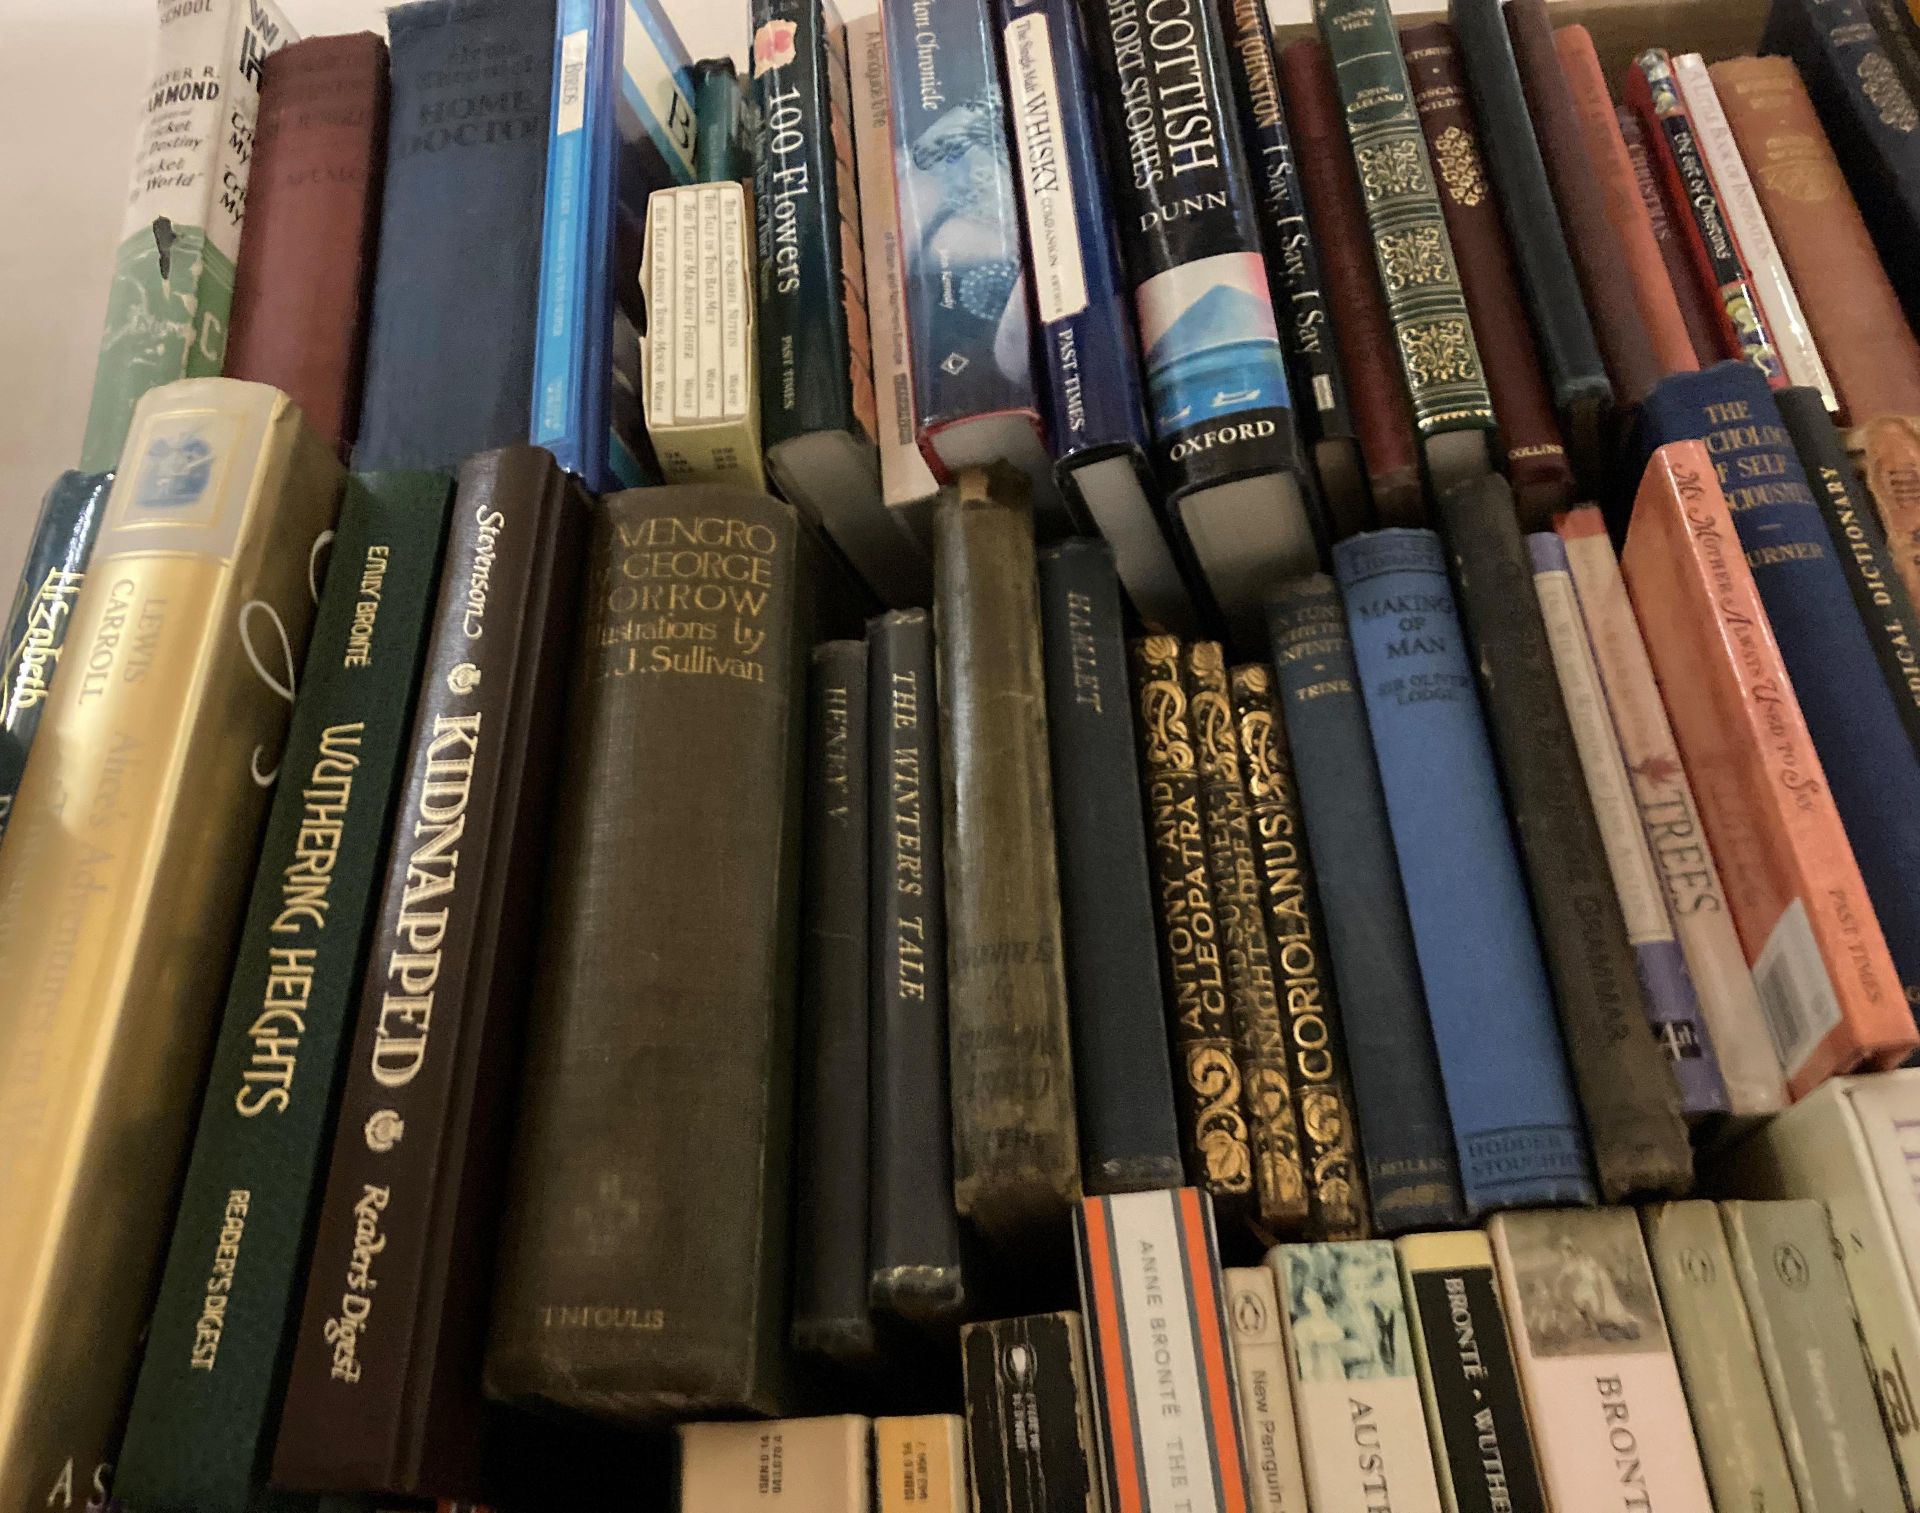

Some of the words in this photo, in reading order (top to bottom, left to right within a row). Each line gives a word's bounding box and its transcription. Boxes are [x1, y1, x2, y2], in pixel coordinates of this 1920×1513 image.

[912, 0, 931, 29] ton
[1015, 20, 1031, 39] The
[1019, 38, 1035, 66] Single
[917, 30, 946, 111] Chronicle
[1147, 0, 1219, 177] COTTISH
[1233, 35, 1281, 129] JOHNSTON
[767, 86, 801, 155] 100
[1024, 90, 1059, 196] WHISKY
[1121, 77, 1163, 189] STORIES
[773, 166, 809, 293] Flowers
[1140, 190, 1227, 233] DUNN
[1058, 328, 1078, 371] PAST
[1064, 373, 1086, 432] TIMES
[1169, 419, 1276, 462] OXFORD
[1704, 401, 1749, 426] THE
[1737, 454, 1788, 479] SELF
[360, 545, 389, 606] EMILY
[466, 504, 505, 640] Stevenson
[622, 551, 773, 588] GEORGE
[1749, 543, 1826, 569] URNER
[1820, 466, 1892, 606] DICTIONARY
[78, 577, 136, 705] CARROLL
[123, 597, 167, 684] LEWIS
[609, 584, 769, 617] ORROW
[650, 646, 764, 683] Sullivan
[1068, 590, 1103, 713] HAMLET
[1387, 637, 1447, 659] MAN
[826, 686, 849, 796] HENRY
[892, 670, 917, 729] THE
[270, 722, 365, 933] WUTHERING
[894, 747, 922, 897] WINTER'S
[1150, 781, 1181, 850] AND
[1644, 790, 1721, 915] TREES
[371, 711, 482, 1087] KIDNAPPED
[1178, 796, 1226, 1016] CLEOPATRA
[1828, 890, 1860, 932] PAST
[898, 916, 925, 1001] TALE
[1161, 878, 1204, 1031] ANTONY
[1259, 811, 1334, 1084] CORIOLANUS
[236, 947, 317, 1118] HEIGHTS
[190, 1295, 228, 1372] DIGEST
[323, 1294, 372, 1385] Digest
[1140, 1239, 1164, 1306] ANNE
[1167, 1438, 1189, 1490] THE
[1251, 1370, 1268, 1413] New
[1261, 1420, 1283, 1504] Penguin
[1595, 1375, 1652, 1513] BRONT
